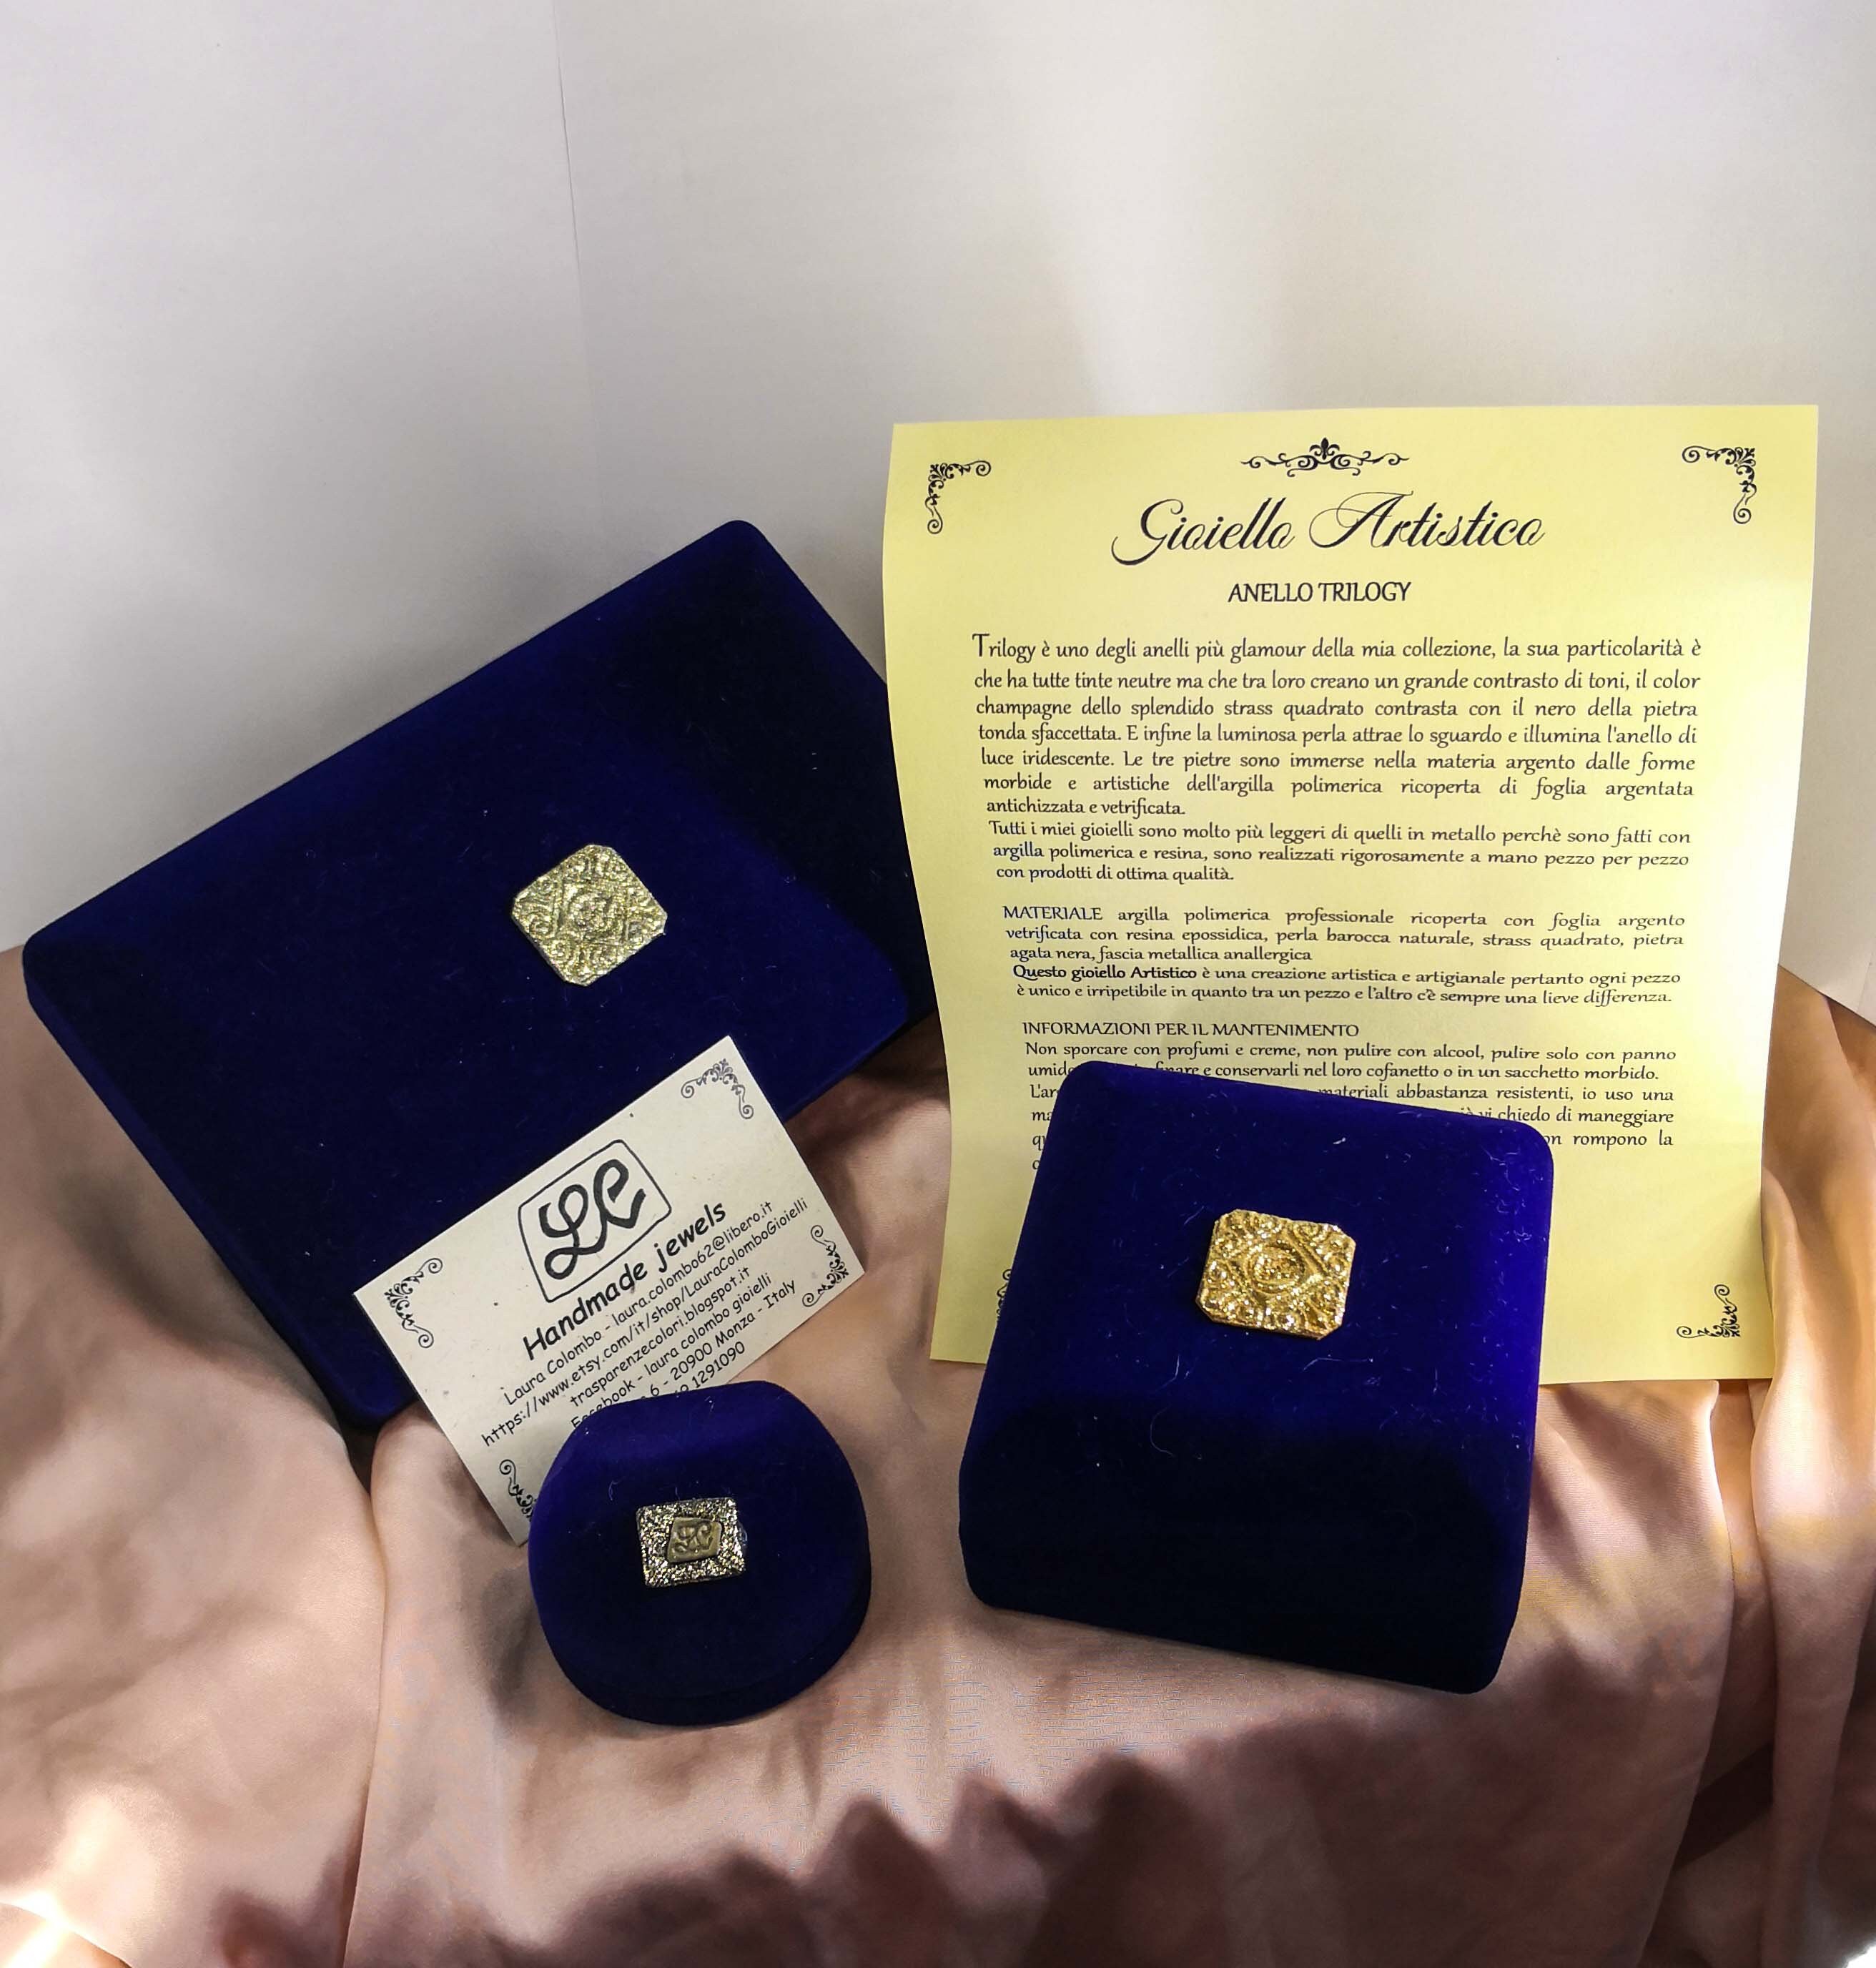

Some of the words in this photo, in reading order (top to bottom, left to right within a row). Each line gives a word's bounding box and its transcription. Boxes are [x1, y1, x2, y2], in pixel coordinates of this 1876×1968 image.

[1111, 497, 1295, 566] Gioiello
[1309, 491, 1545, 548] Artistico
[1228, 582, 1313, 603] ANELLO
[1318, 581, 1411, 601] TRILOGY
[972, 633, 1036, 664] Trilogy
[1042, 640, 1050, 657] è
[1056, 646, 1089, 657] uno
[1096, 637, 1136, 664] degli
[1143, 637, 1189, 657] anelli
[1196, 640, 1224, 664] più
[1230, 637, 1306, 664] glamour
[1312, 636, 1355, 657] della
[1362, 640, 1396, 656] mia
[1403, 636, 1496, 659] collezione,
[1504, 636, 1520, 656] la
[1527, 644, 1559, 656] sua
[1567, 636, 1684, 663] particolarità
[1692, 639, 1702, 656] è
[976, 695, 1071, 720] champagne
[1082, 696, 1121, 714] dello
[1131, 697, 1214, 721] splendido
[1224, 700, 1273, 715] strass
[1283, 697, 1363, 722] quadrato
[1375, 700, 1458, 716] contrasta
[1469, 705, 1501, 716] con
[1513, 697, 1524, 716] il
[1535, 705, 1576, 716] nero
[1588, 697, 1632, 716] della
[1644, 700, 1698, 722] pietra
[979, 722, 1027, 739] tonda
[1032, 722, 1121, 746] sfaccettata.
[1127, 725, 1138, 740] E
[1144, 723, 1191, 747] infine
[1198, 723, 1212, 741] la
[1218, 723, 1297, 742] luminosa
[1302, 724, 1347, 747] perla
[1353, 727, 1402, 742] attrae
[1409, 724, 1423, 742] lo
[1430, 724, 1502, 748] sguardo
[1508, 732, 1517, 742] e
[1524, 724, 1601, 743] illumina
[1679, 724, 1697, 743] di
[987, 796, 1085, 813] antichizzata
[1089, 804, 1097, 813] e
[1100, 797, 1185, 820] vetrificata.
[993, 841, 1045, 861] argilla
[1049, 842, 1135, 862] polimerica
[1139, 850, 1147, 859] e
[1153, 847, 1208, 861] resina,
[1213, 850, 1252, 860] sono
[1258, 845, 1335, 861] realizzati
[1341, 849, 1464, 866] rigorosamente
[1471, 853, 1481, 862] a
[1488, 854, 1538, 863] mano
[1545, 855, 1594, 869] pezzo
[1602, 856, 1633, 870] per
[1639, 856, 1689, 870] pezzo
[997, 869, 1025, 877] con
[1029, 864, 1092, 882] prodotti
[1096, 865, 1112, 879] di
[1116, 867, 1169, 880] ottima
[1172, 865, 1234, 885] qualità.
[1002, 906, 1103, 920] MATERIALE
[1118, 906, 1170, 925] argilla
[1184, 906, 1270, 925] polimerica
[1285, 907, 1393, 925] professionale
[1411, 912, 1487, 928] ricoperta
[1504, 917, 1534, 926] con
[1548, 912, 1601, 931] foglia
[1618, 915, 1685, 930] argento
[1013, 965, 1067, 981] Questo
[1071, 965, 1125, 982] gioiello
[1130, 966, 1197, 978] Artistico
[1202, 967, 1210, 978] è
[1251, 968, 1326, 980] creazione
[1331, 969, 1397, 981] artistica
[1416, 970, 1505, 987] artigianale
[1511, 973, 1584, 988] pertanto
[1589, 972, 1626, 988] ogni
[1632, 975, 1681, 987] pezzo
[1017, 984, 1025, 995] è
[1029, 985, 1070, 996] unico
[1087, 983, 1167, 1000] irripetibile
[1172, 986, 1187, 997] in
[1191, 986, 1247, 1001] quanto
[1252, 986, 1274, 998] tra
[1305, 990, 1351, 1003] pezzo
[1440, 993, 1500, 1006] sempre
[1544, 990, 1579, 1003] lieve
[1584, 989, 1672, 1007] differenza.
[1022, 1022, 1150, 1035] INFORMAZIONI
[1155, 1023, 1189, 1035] PER
[1192, 1023, 1209, 1035] IL
[1212, 1023, 1359, 1037] MANTENIMENTO
[1215, 1061, 1299, 1076] conservarli
[1303, 1061, 1327, 1076] nel
[1332, 1062, 1362, 1076] loro
[1366, 1063, 1439, 1082] cofanetto
[1458, 1066, 1473, 1077] in
[1478, 1069, 1501, 1078] un
[1505, 1064, 1579, 1078] sacchetto
[1584, 1066, 1659, 1079] morbido.
[1397, 1083, 1488, 1099] abbastanza
[1496, 1086, 1573, 1101] resistenti,
[1583, 1087, 1596, 1100] io
[1605, 1091, 1633, 1100] uso
[1642, 1092, 1674, 1101] una
[1499, 1106, 1550, 1121] chiedo
[1556, 1106, 1572, 1121] di
[1578, 1110, 1674, 1128] maneggiare
[1573, 1136, 1647, 1151] rompono
[1659, 1129, 1674, 1146] la
[523, 1262, 648, 1361] Handmade
[654, 1203, 726, 1273] jewels
[504, 1372, 546, 1405] Laura
[547, 1332, 601, 1374] Colombo
[612, 1201, 772, 1326] laura.colombo62@libero.it
[481, 1197, 808, 1447] https://www.etsy.com/it/shop/LauraColomboGioielli
[644, 1348, 679, 1376] laura
[681, 1309, 729, 1349] colombo
[733, 1272, 771, 1314] gioielli
[671, 1343, 713, 1380] 20900
[715, 1313, 756, 1347] Monza
[763, 1280, 795, 1309] Italy
[570, 1267, 749, 1407] trasparenzecolori.blogspot.it
[692, 1342, 745, 1388] 1291090
